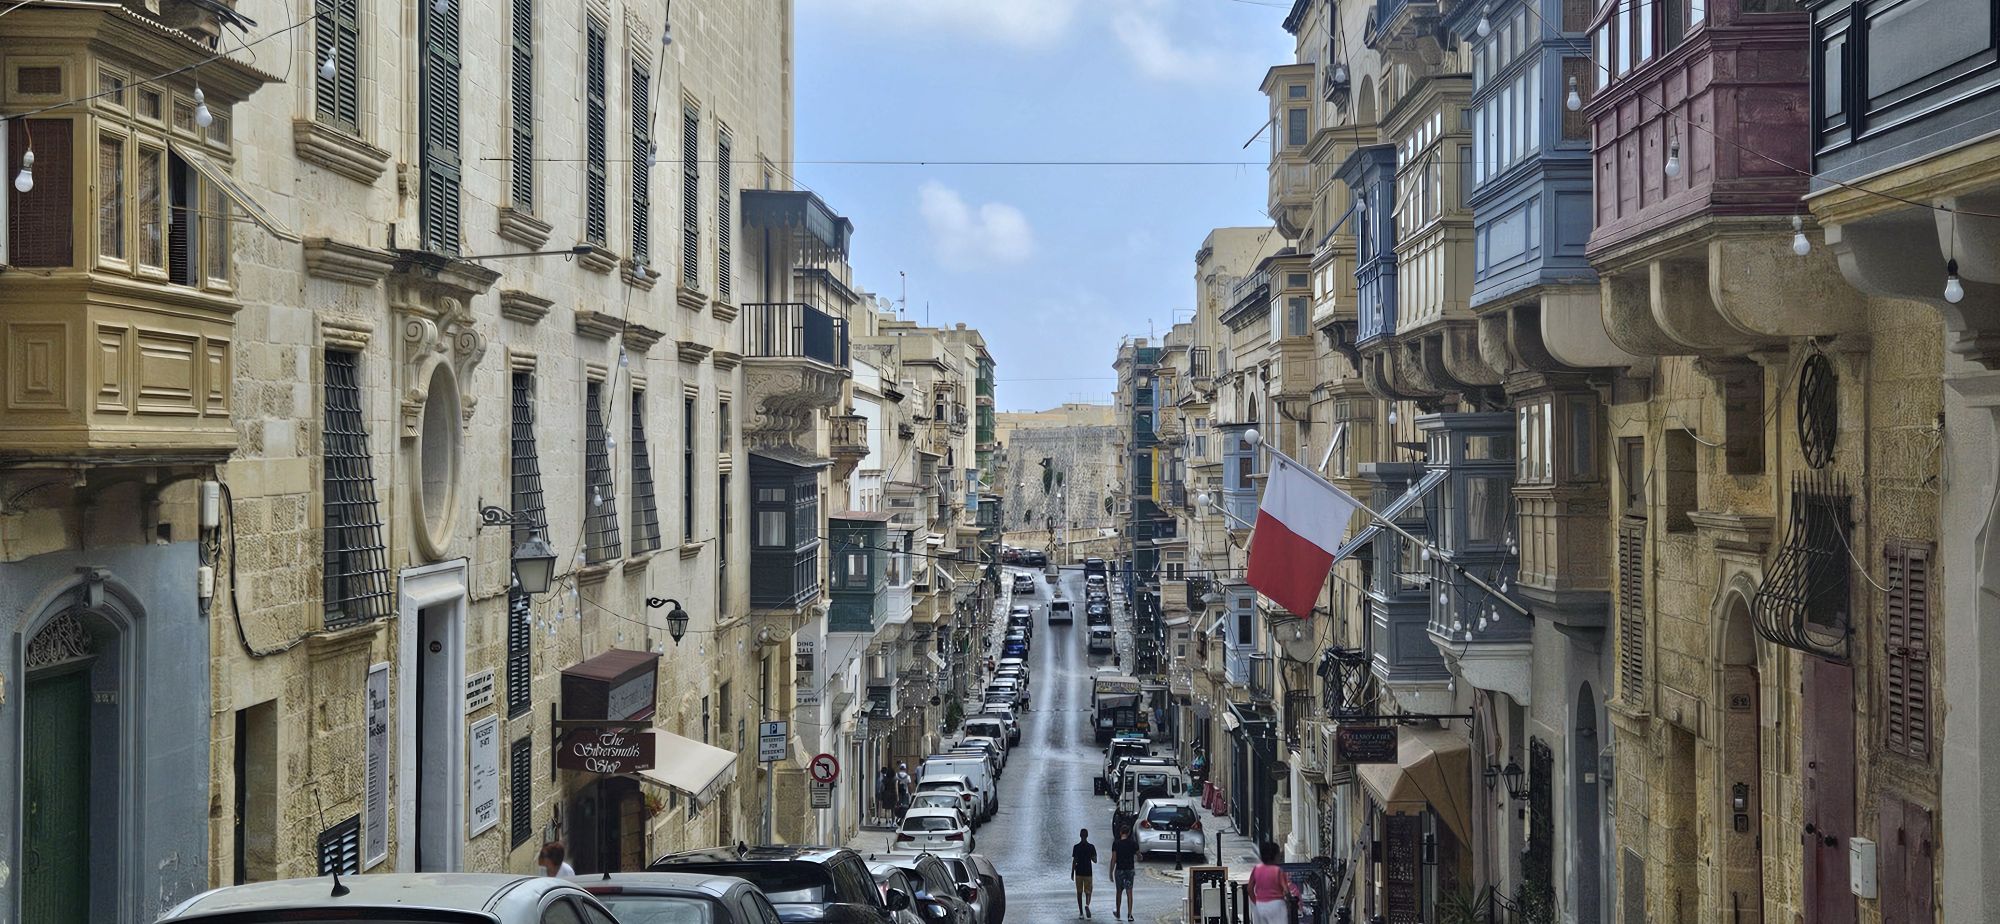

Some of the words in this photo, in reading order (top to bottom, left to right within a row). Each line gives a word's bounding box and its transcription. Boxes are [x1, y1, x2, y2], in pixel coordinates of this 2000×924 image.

[599, 732, 624, 746] The
[573, 742, 640, 757] Silversmith's
[586, 757, 621, 774] Shop
